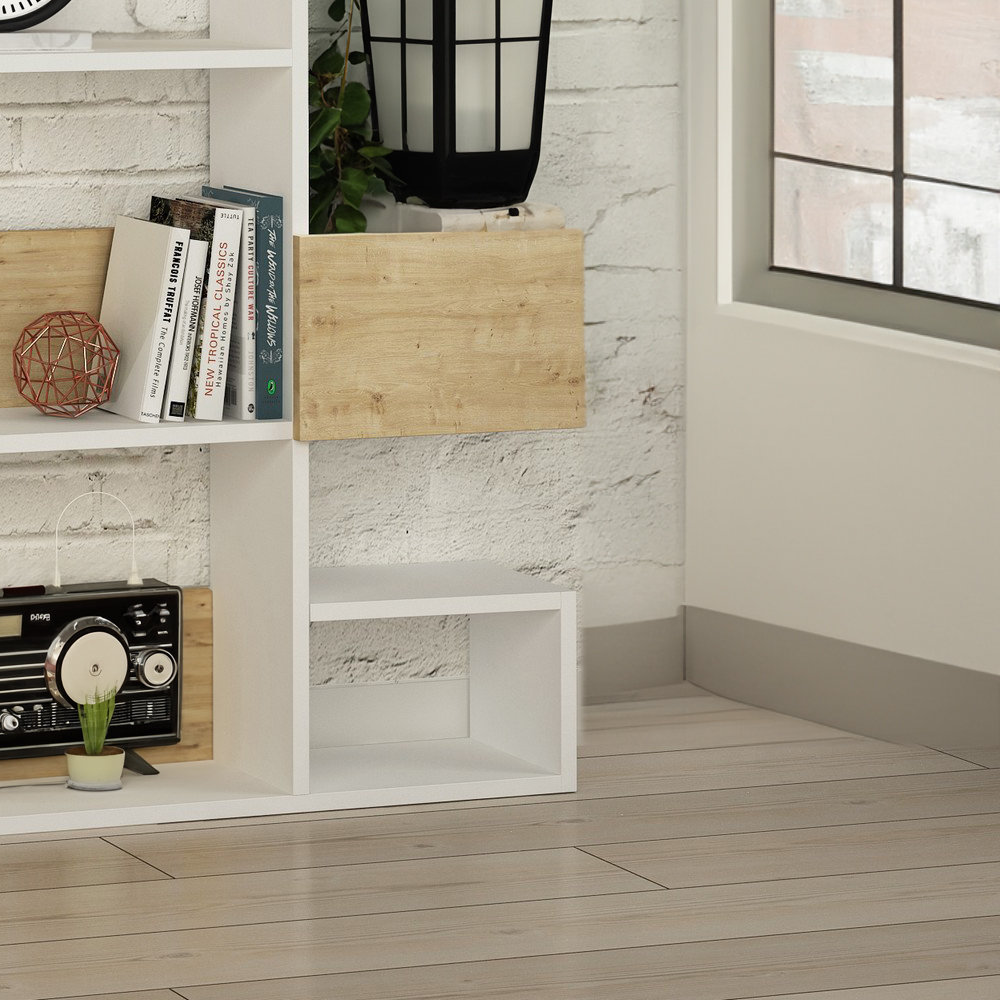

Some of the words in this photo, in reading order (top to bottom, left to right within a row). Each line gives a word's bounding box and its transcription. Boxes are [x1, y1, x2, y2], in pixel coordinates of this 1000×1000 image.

[267, 228, 277, 249] THE
[193, 275, 202, 295] JOSEF
[213, 241, 228, 301] CLASSICS
[225, 272, 234, 293] Shay
[163, 287, 176, 323] TRUFFAT
[224, 297, 231, 308] by
[266, 288, 278, 304] THE
[188, 294, 200, 332] HOFFMANN
[220, 311, 229, 342] Homes
[265, 304, 278, 347] WILLOWS
[159, 326, 168, 340] The
[207, 305, 222, 364] TROPICAL
[153, 341, 166, 377] Complete
[215, 346, 225, 388] Hawaiian
[149, 377, 160, 398] Films
[204, 368, 215, 397] NEW
